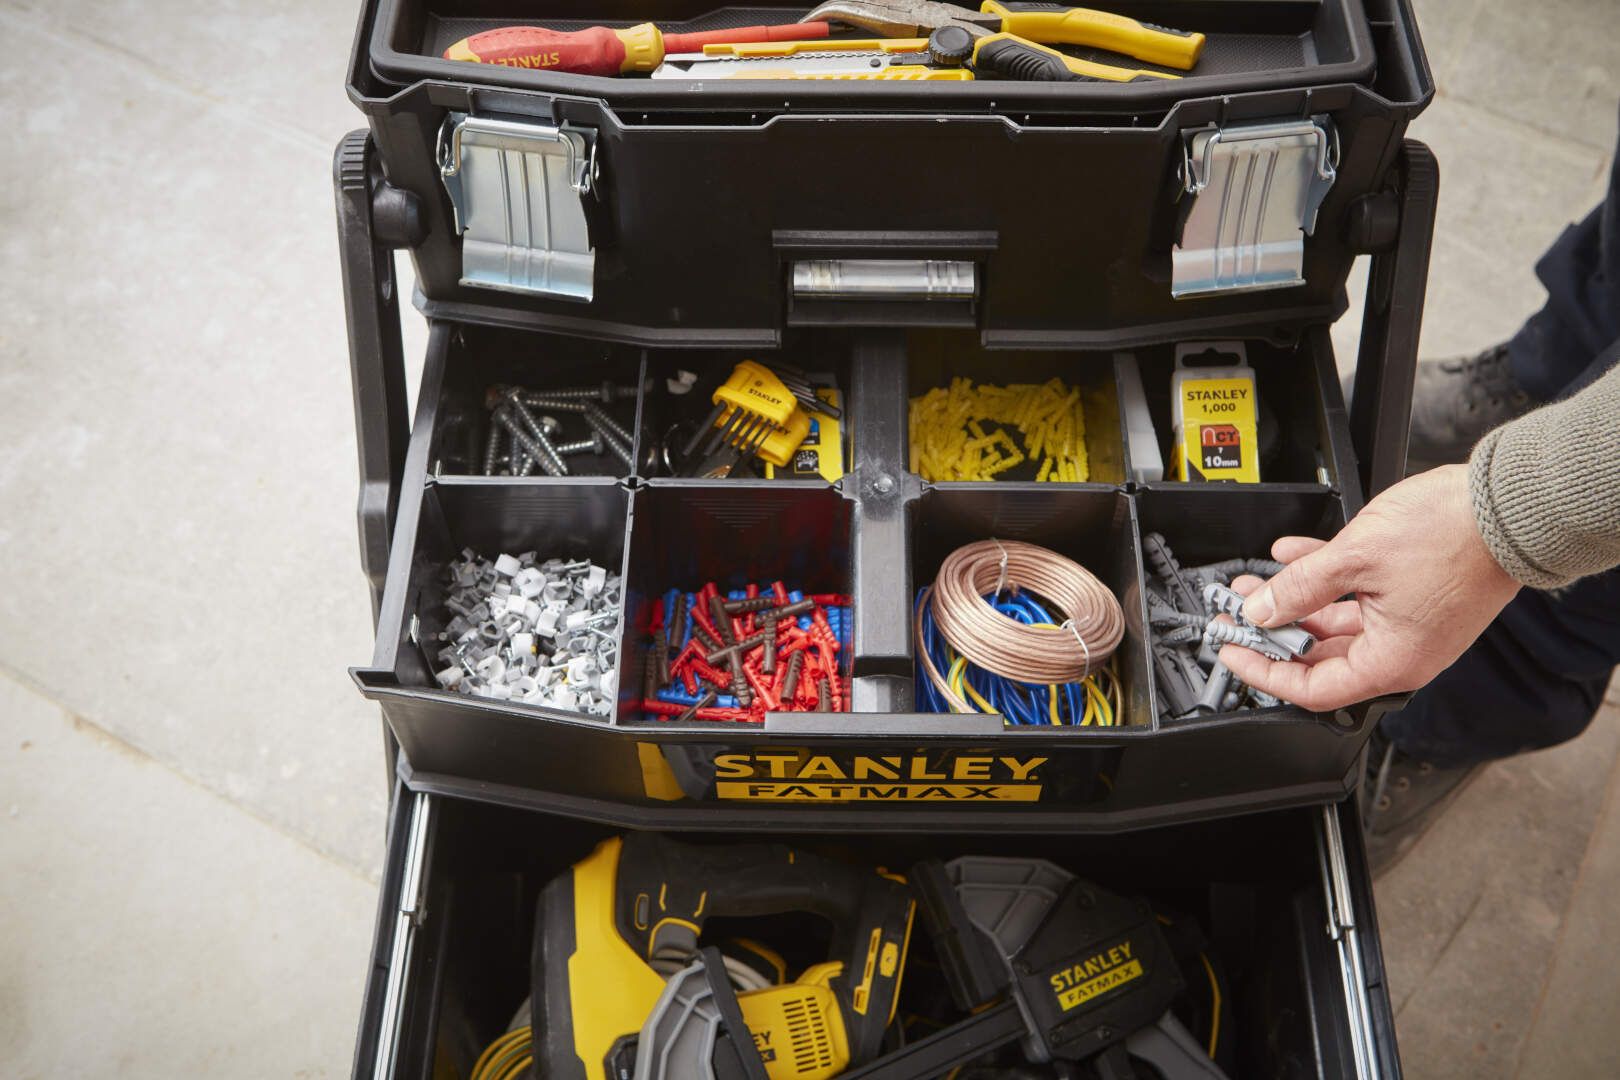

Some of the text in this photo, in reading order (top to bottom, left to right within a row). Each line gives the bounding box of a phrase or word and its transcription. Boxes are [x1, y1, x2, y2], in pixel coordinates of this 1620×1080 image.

[748, 388, 782, 405] STANLEY
[1187, 389, 1247, 401] STANLEY
[1202, 403, 1236, 413] 1,000
[1205, 455, 1238, 467] 10mm
[714, 755, 1048, 780] STANLEY
[748, 785, 1001, 798] FATMAX
[1050, 942, 1131, 993] STANLEY
[1067, 966, 1134, 1003] FATMAX
